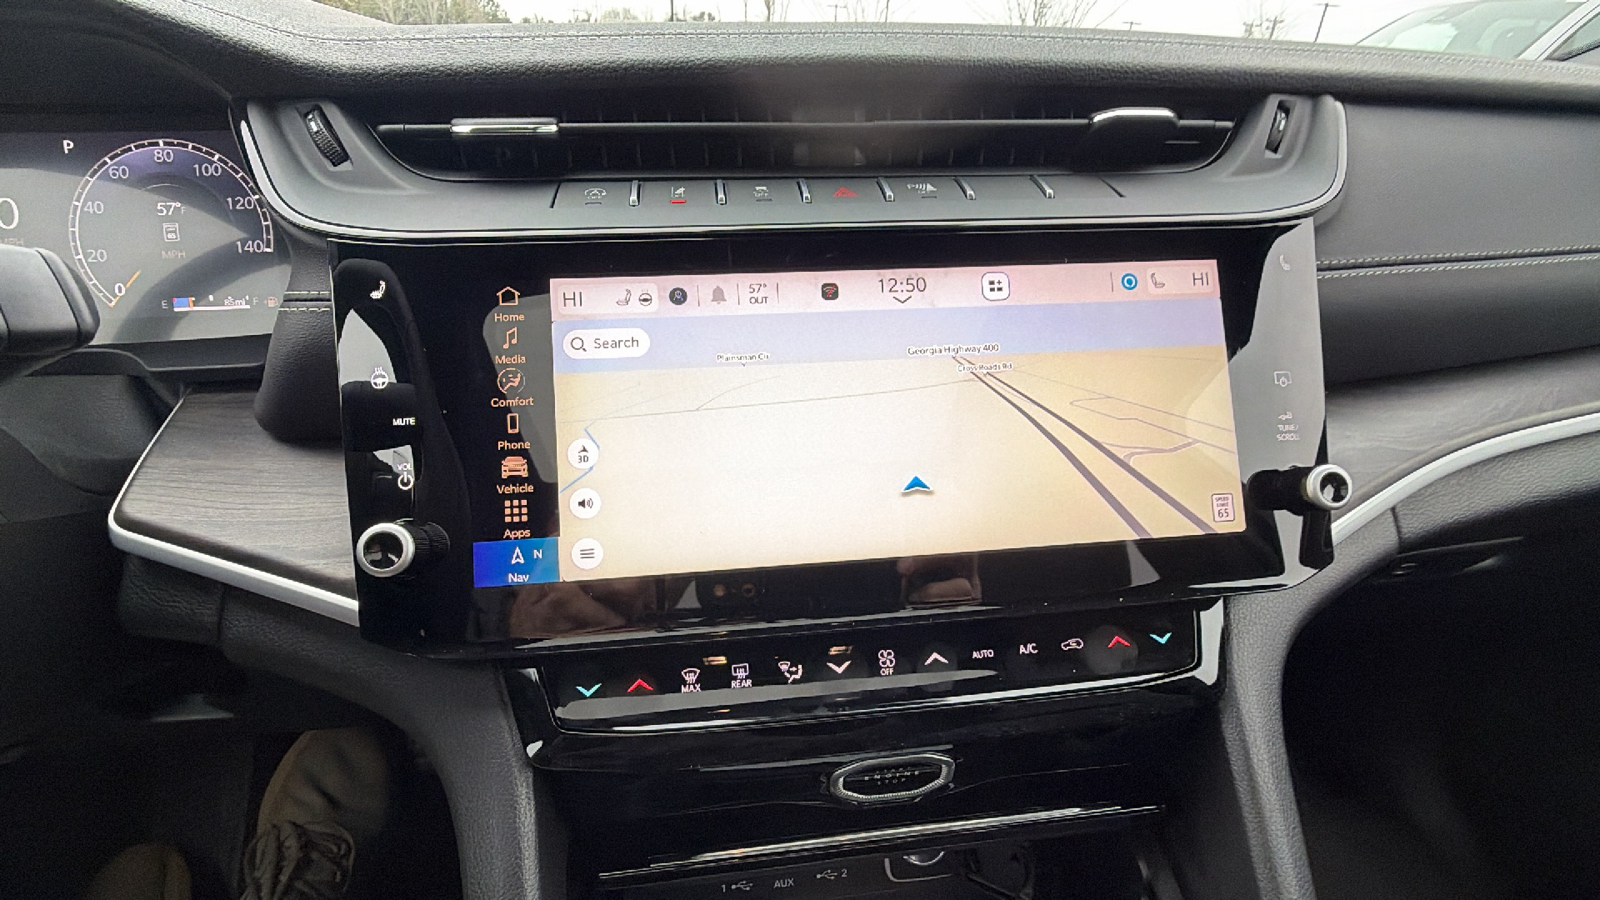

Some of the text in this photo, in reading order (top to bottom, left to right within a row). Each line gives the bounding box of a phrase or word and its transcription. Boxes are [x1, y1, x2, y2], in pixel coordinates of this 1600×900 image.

[63, 139, 74, 153] P
[154, 149, 174, 163] 80
[108, 165, 130, 179] 60
[193, 163, 222, 177] 100
[83, 201, 104, 214] 40
[226, 196, 254, 210] 120
[236, 239, 264, 254] 140
[87, 249, 108, 262] 20
[161, 250, 186, 259] MPH
[114, 283, 125, 296] 0
[563, 291, 583, 307] HI
[878, 276, 927, 293] 12:50
[1191, 272, 1210, 287] HI
[161, 300, 168, 309] E
[749, 296, 769, 305] OUT
[494, 312, 525, 322] Home
[593, 336, 640, 349] Search
[908, 343, 999, 356] Georgia Highway 400
[495, 354, 526, 364] Media
[979, 363, 1001, 371] Roads
[1002, 362, 1013, 370] Rd
[490, 396, 535, 408] Comfort
[392, 417, 416, 426] MUTE
[497, 440, 531, 451] Phone
[577, 454, 589, 464] 3D
[397, 463, 413, 472] VOL
[496, 483, 534, 494] Vehicle
[1217, 508, 1230, 518] 65
[503, 529, 531, 540] Apps
[533, 549, 543, 559] N
[508, 572, 530, 583] Nav
[972, 649, 995, 659] AUTO
[1018, 643, 1039, 655] A/C
[880, 668, 894, 676] OFF
[681, 684, 702, 694] MAX
[731, 679, 753, 689] REAR
[841, 868, 848, 878] 2
[721, 884, 727, 893] 1
[773, 878, 795, 889] AUX
